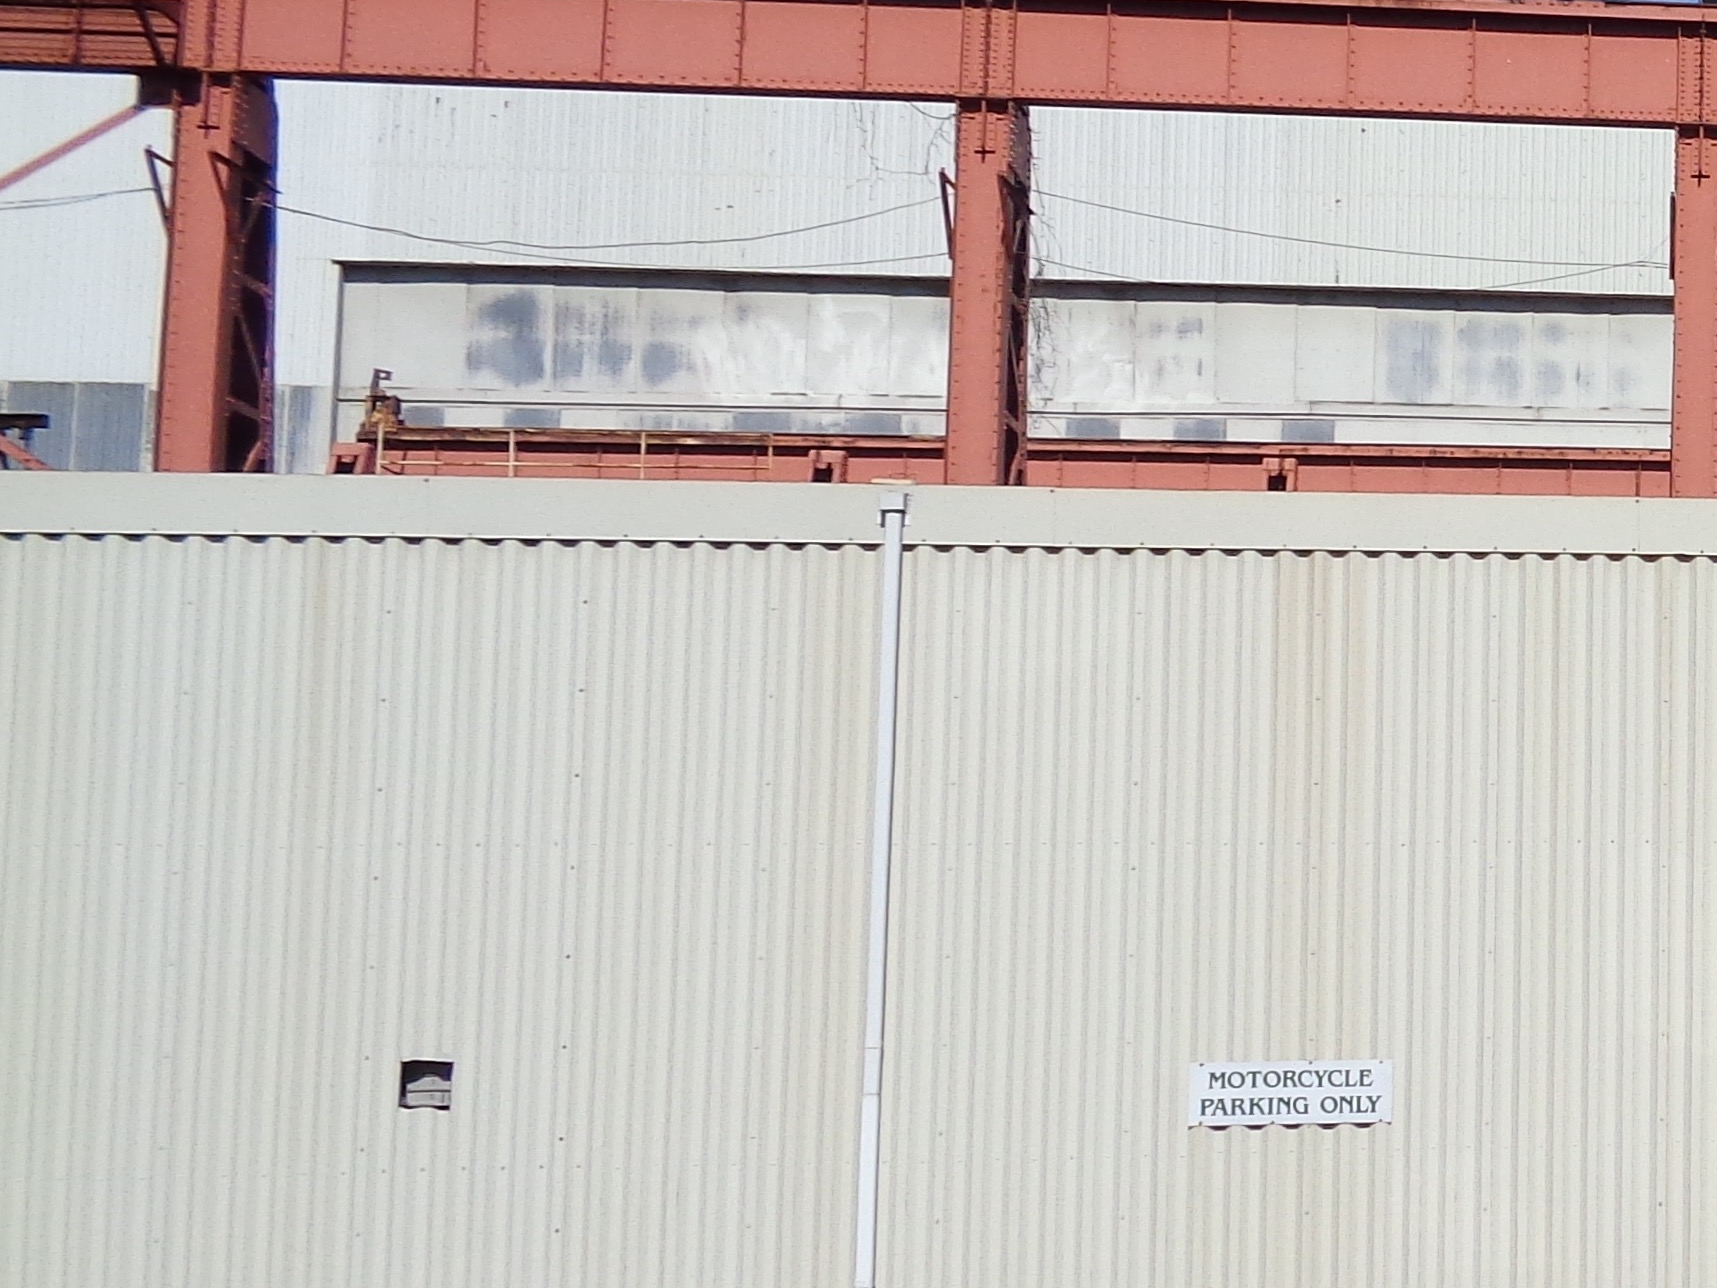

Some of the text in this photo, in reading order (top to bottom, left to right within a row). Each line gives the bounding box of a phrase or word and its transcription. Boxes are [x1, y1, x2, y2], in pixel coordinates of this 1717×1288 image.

[1208, 1069, 1374, 1090] MOTORCYCLE
[1200, 1095, 1383, 1117] PARKING ONLY
